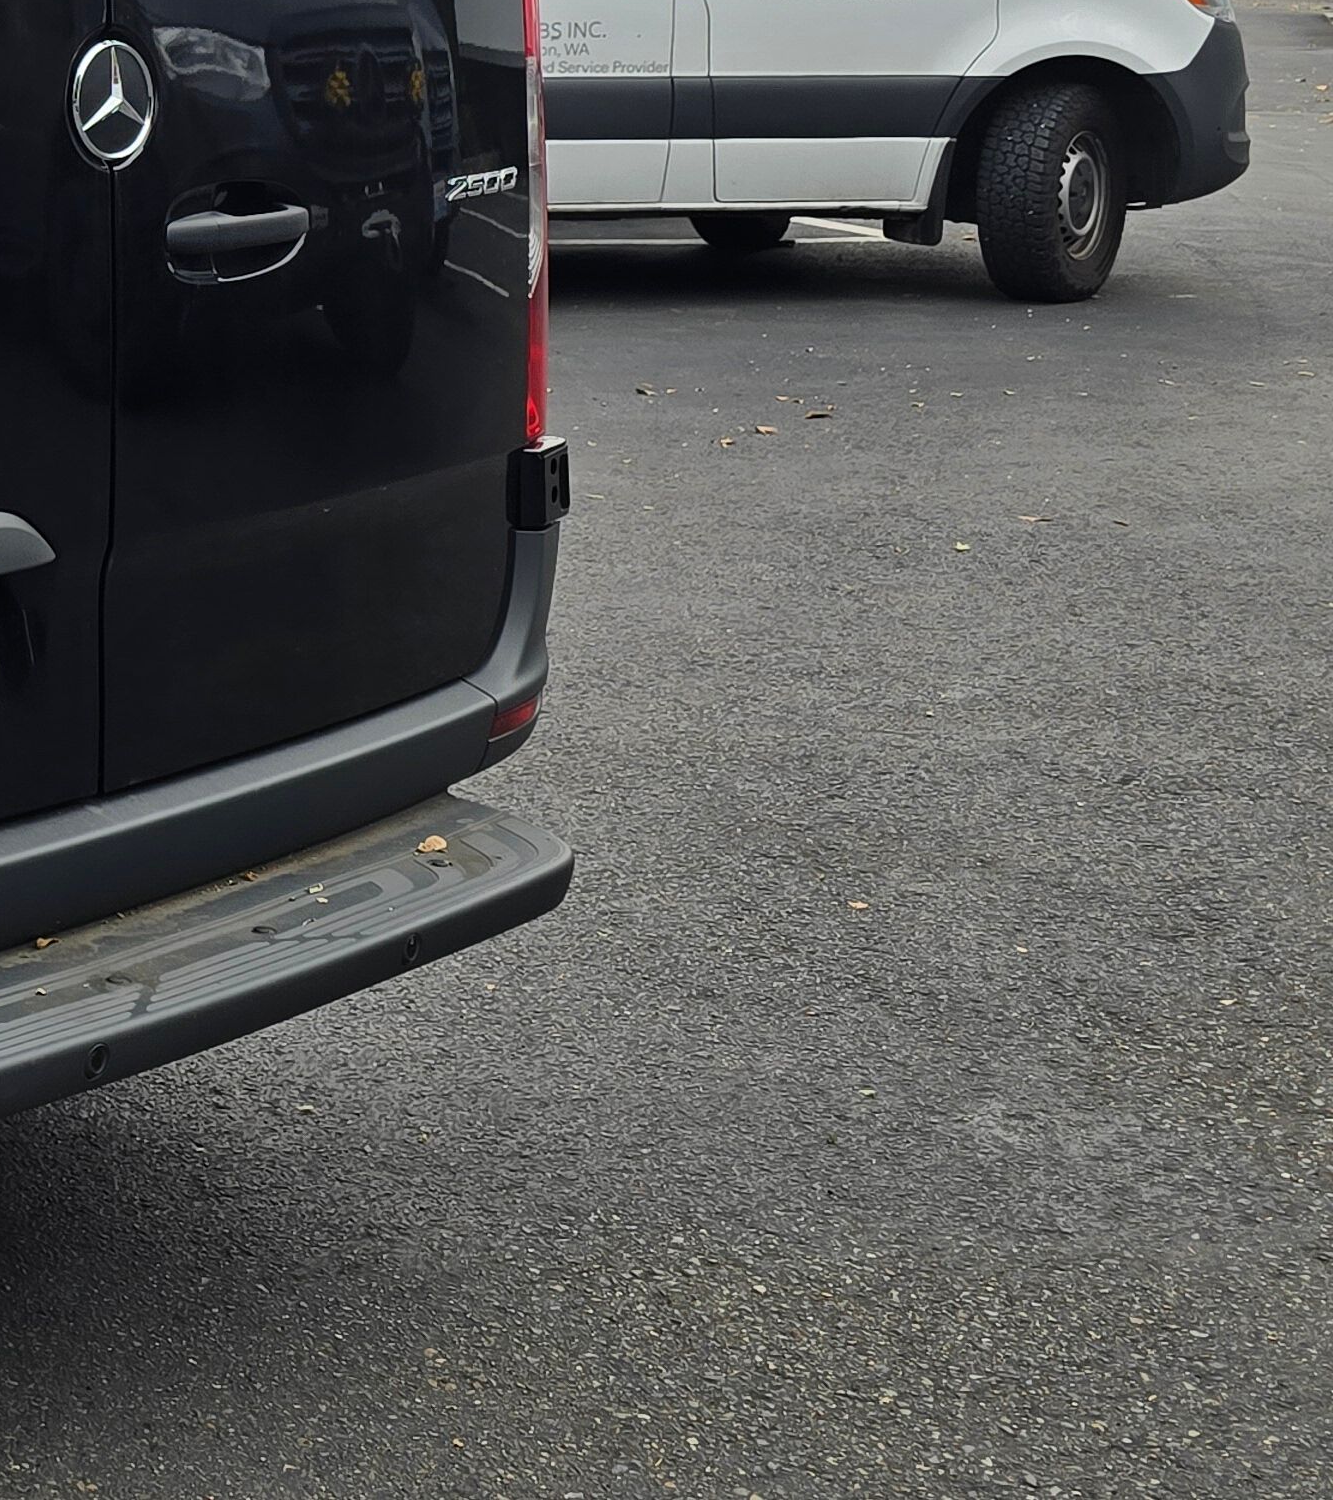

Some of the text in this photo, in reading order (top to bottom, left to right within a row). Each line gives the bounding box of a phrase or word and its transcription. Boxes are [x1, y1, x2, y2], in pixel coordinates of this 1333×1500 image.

[568, 21, 606, 39] INC.
[564, 43, 589, 56] WA
[558, 61, 610, 74] Service
[613, 60, 669, 74] Provider
[445, 166, 518, 201] 2500
